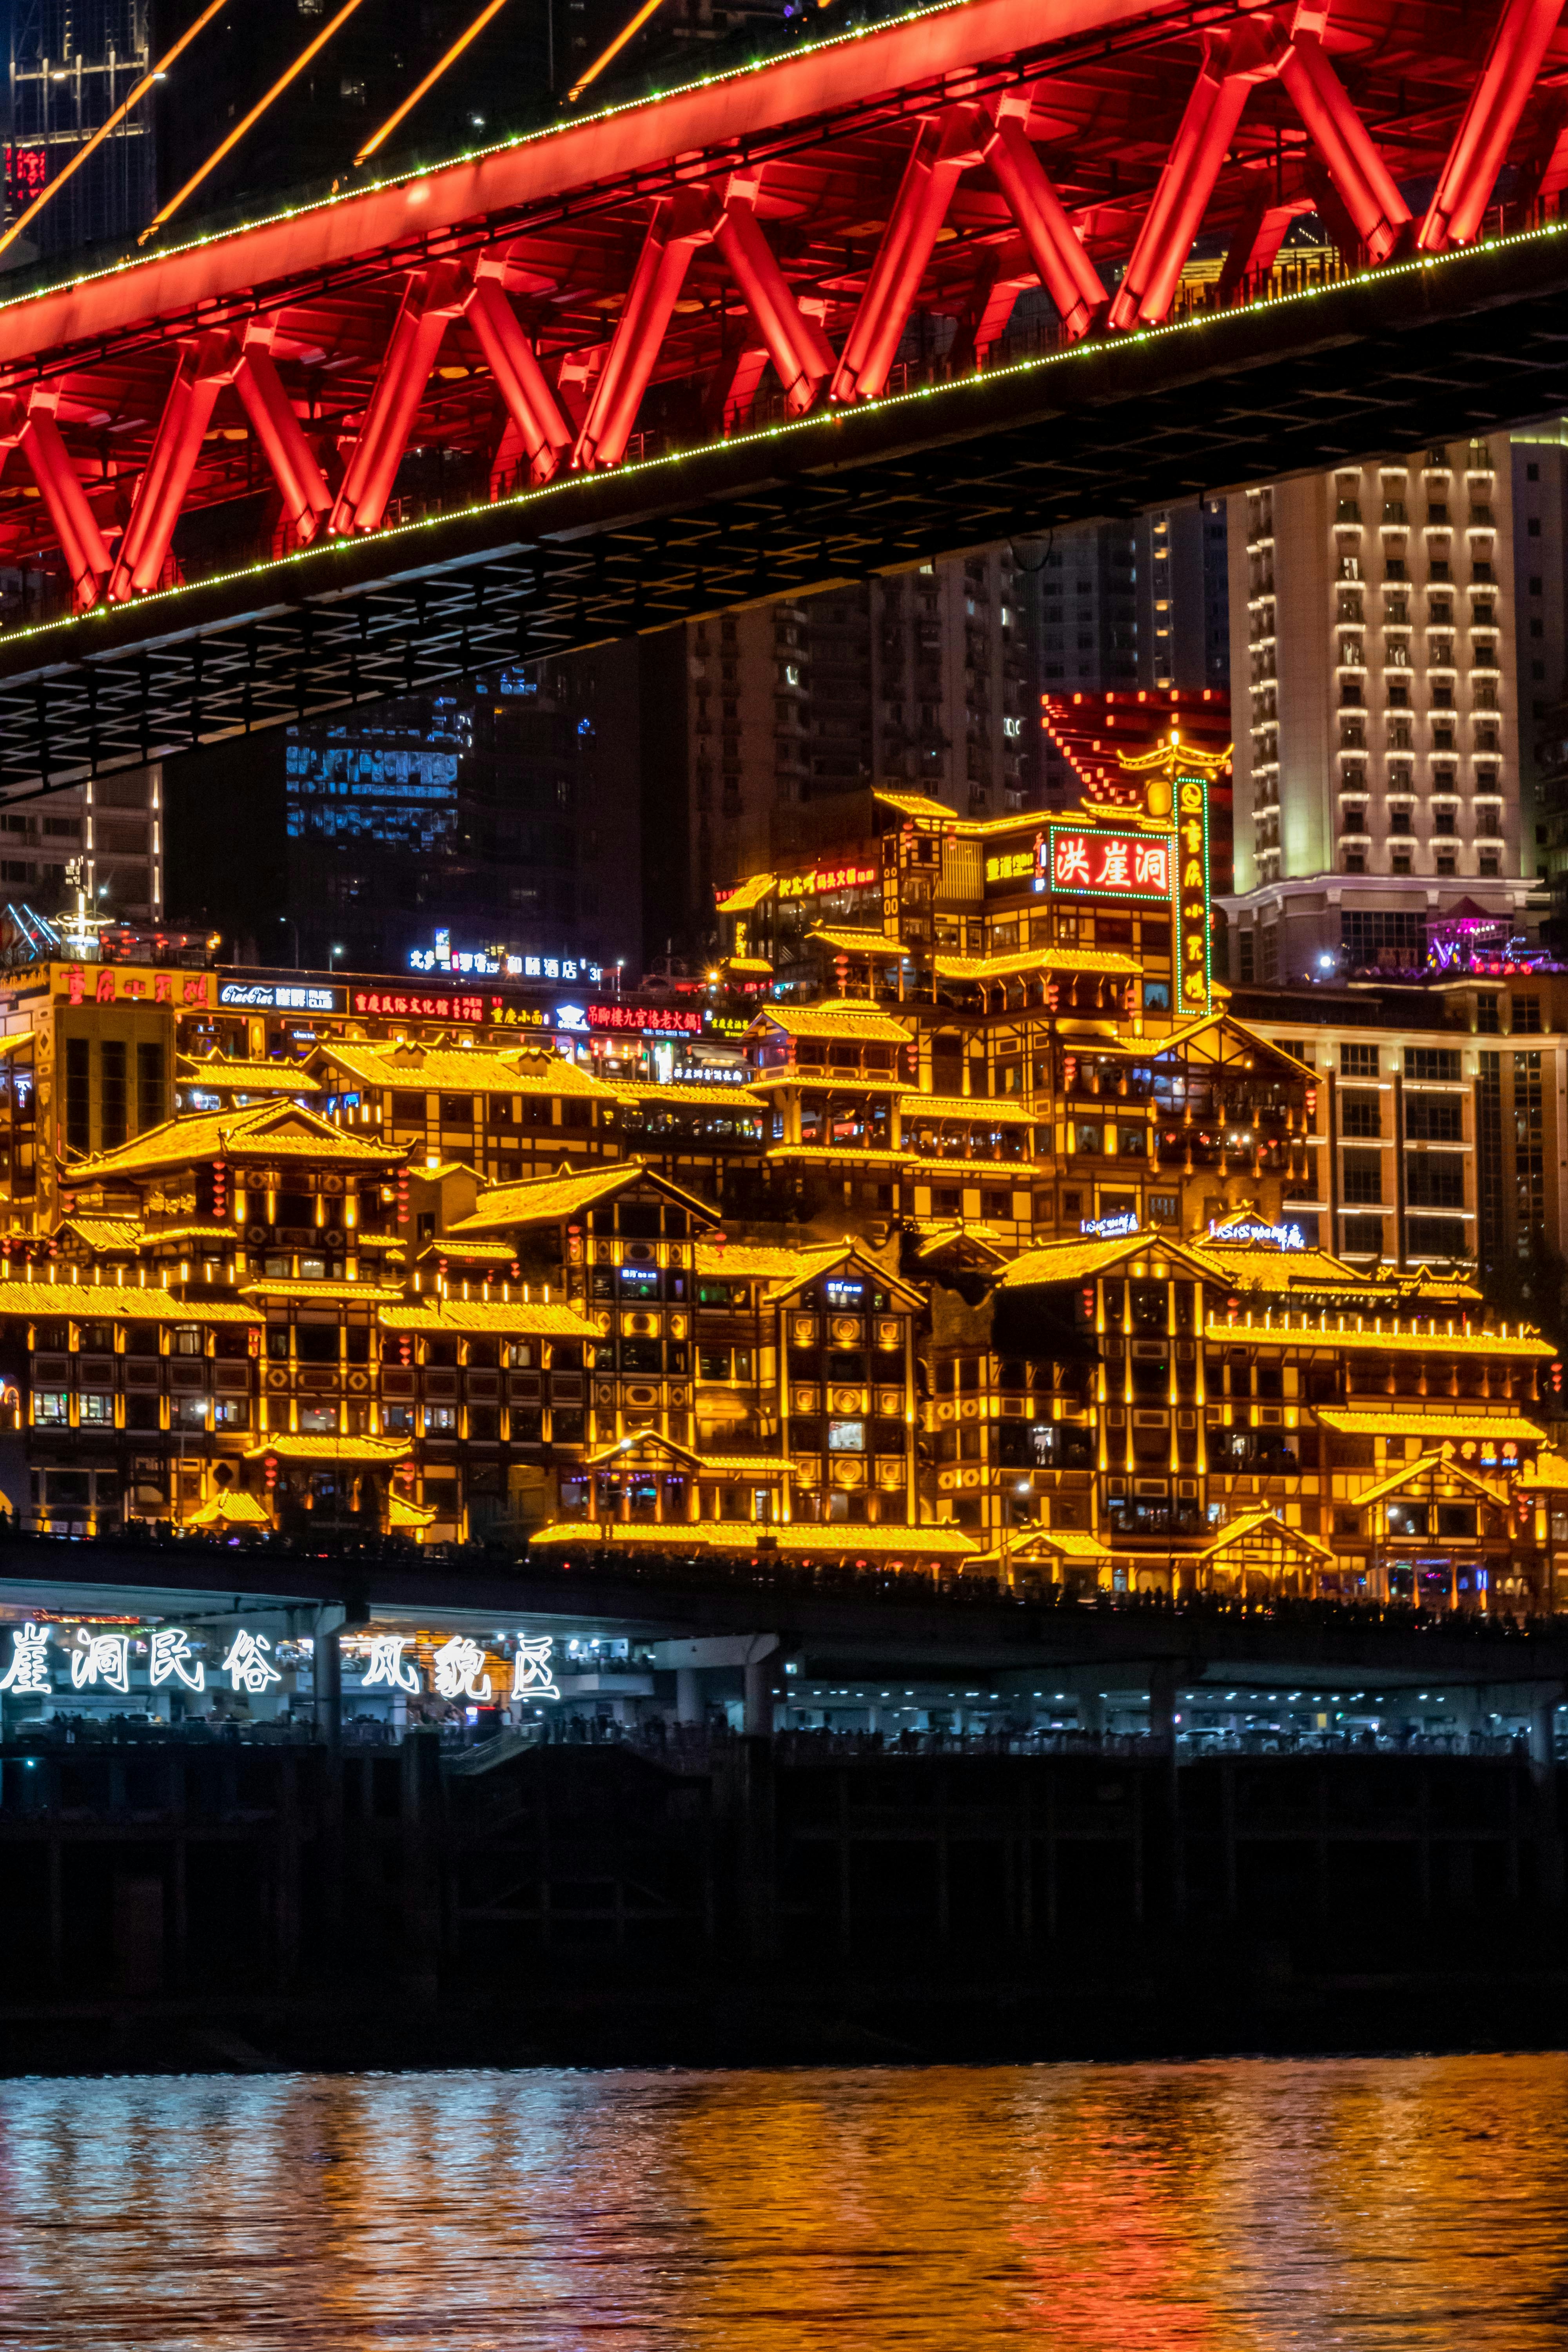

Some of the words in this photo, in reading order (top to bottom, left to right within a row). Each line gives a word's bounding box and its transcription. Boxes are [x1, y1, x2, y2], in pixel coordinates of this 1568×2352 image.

[1057, 838, 1167, 889] 洪崖洞
[507, 956, 577, 979] 和颐酒店
[361, 1635, 561, 1700] 风貌区
